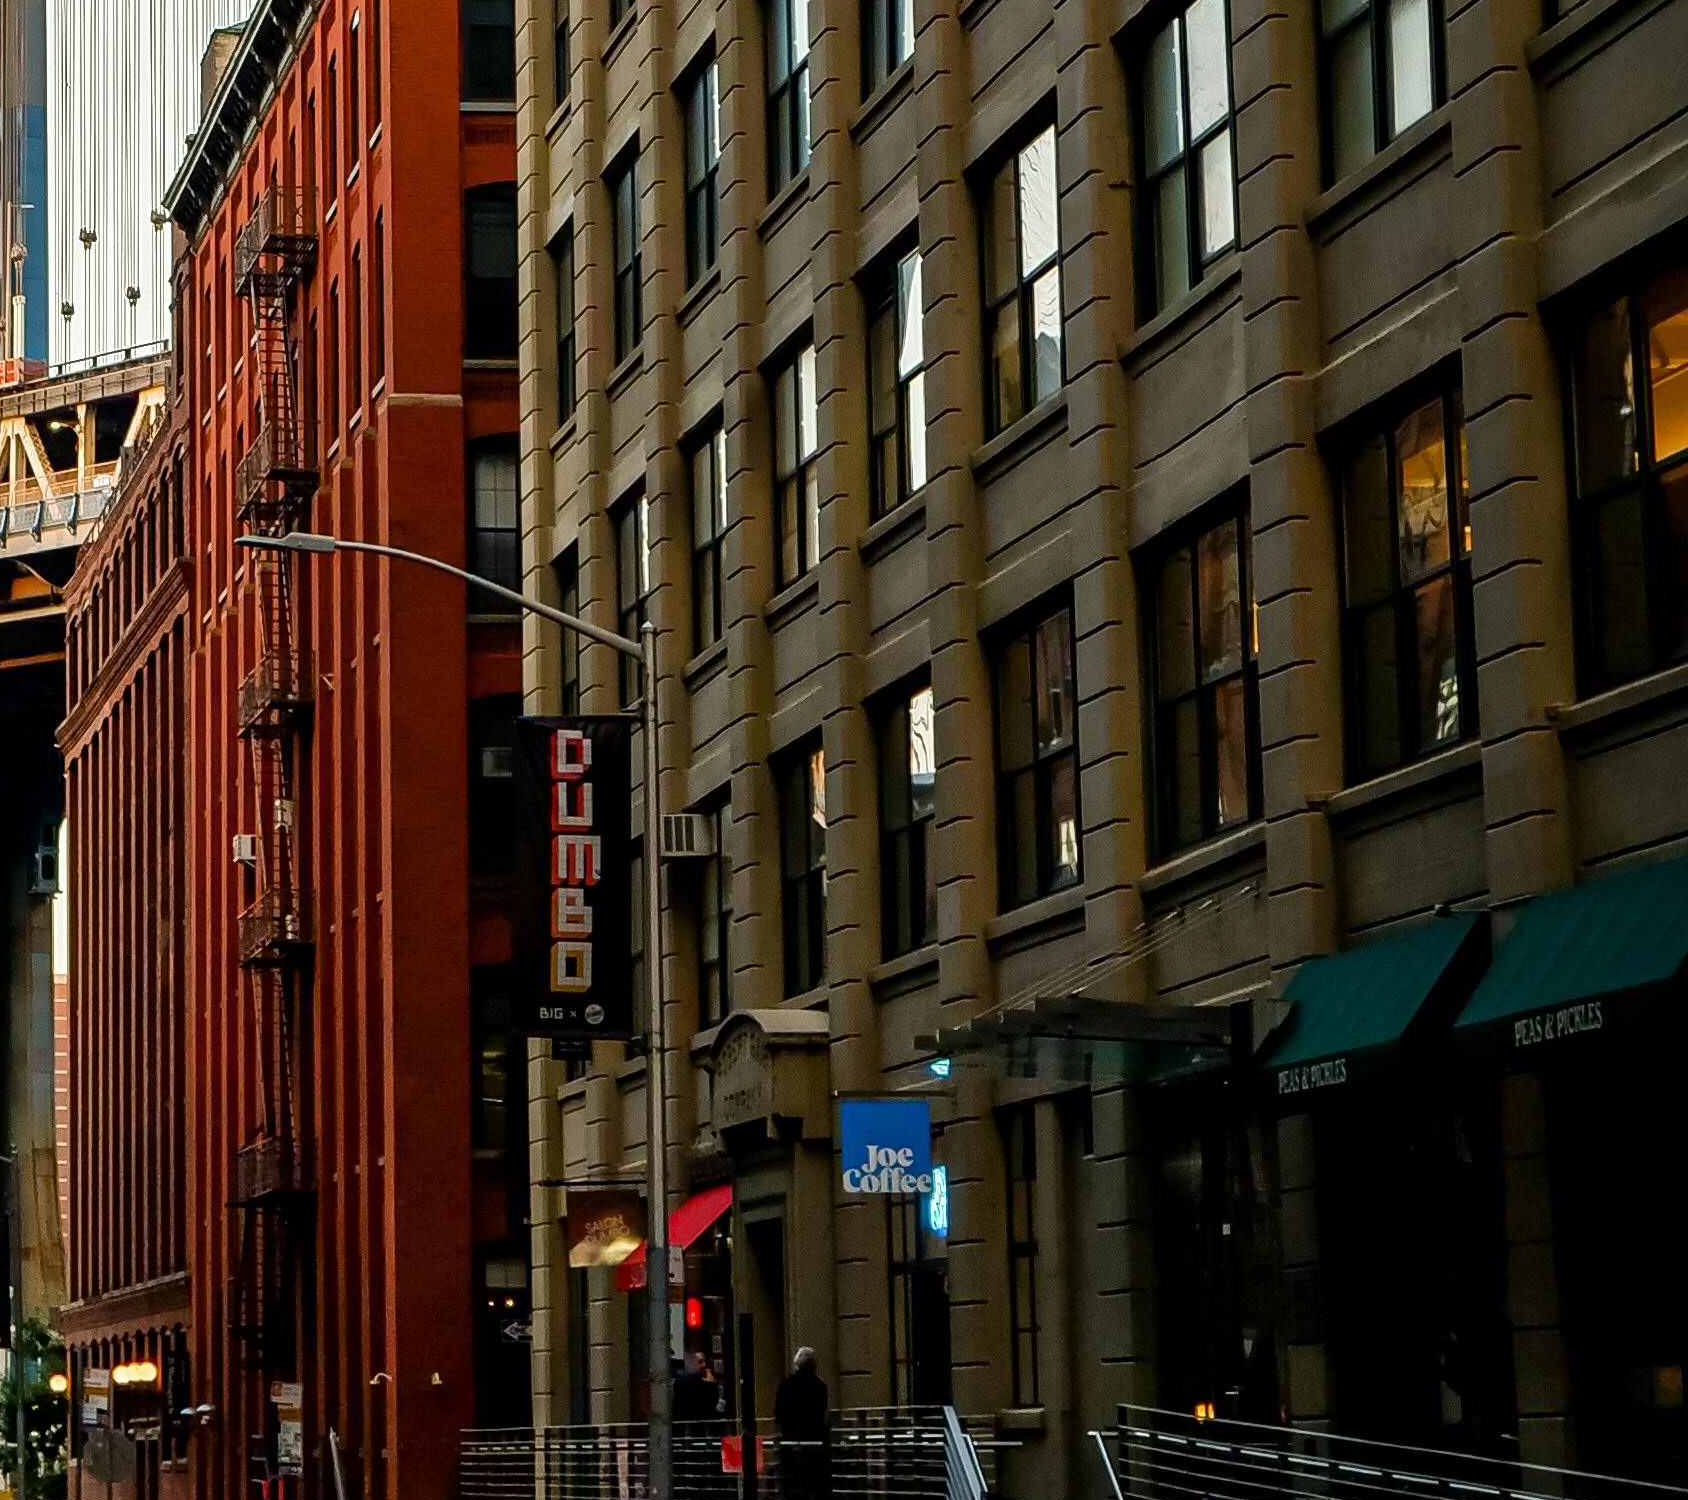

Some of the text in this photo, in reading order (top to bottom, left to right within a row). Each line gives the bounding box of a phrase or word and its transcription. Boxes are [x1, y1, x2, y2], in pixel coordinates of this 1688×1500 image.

[550, 729, 602, 994] DUMBO
[539, 1006, 564, 1020] BIG
[1514, 1001, 1603, 1048] PEAS & PICKLES
[1278, 1058, 1347, 1095] PEAS & PICKLES
[862, 1144, 914, 1173] Joe
[842, 1167, 932, 1193] Coffee
